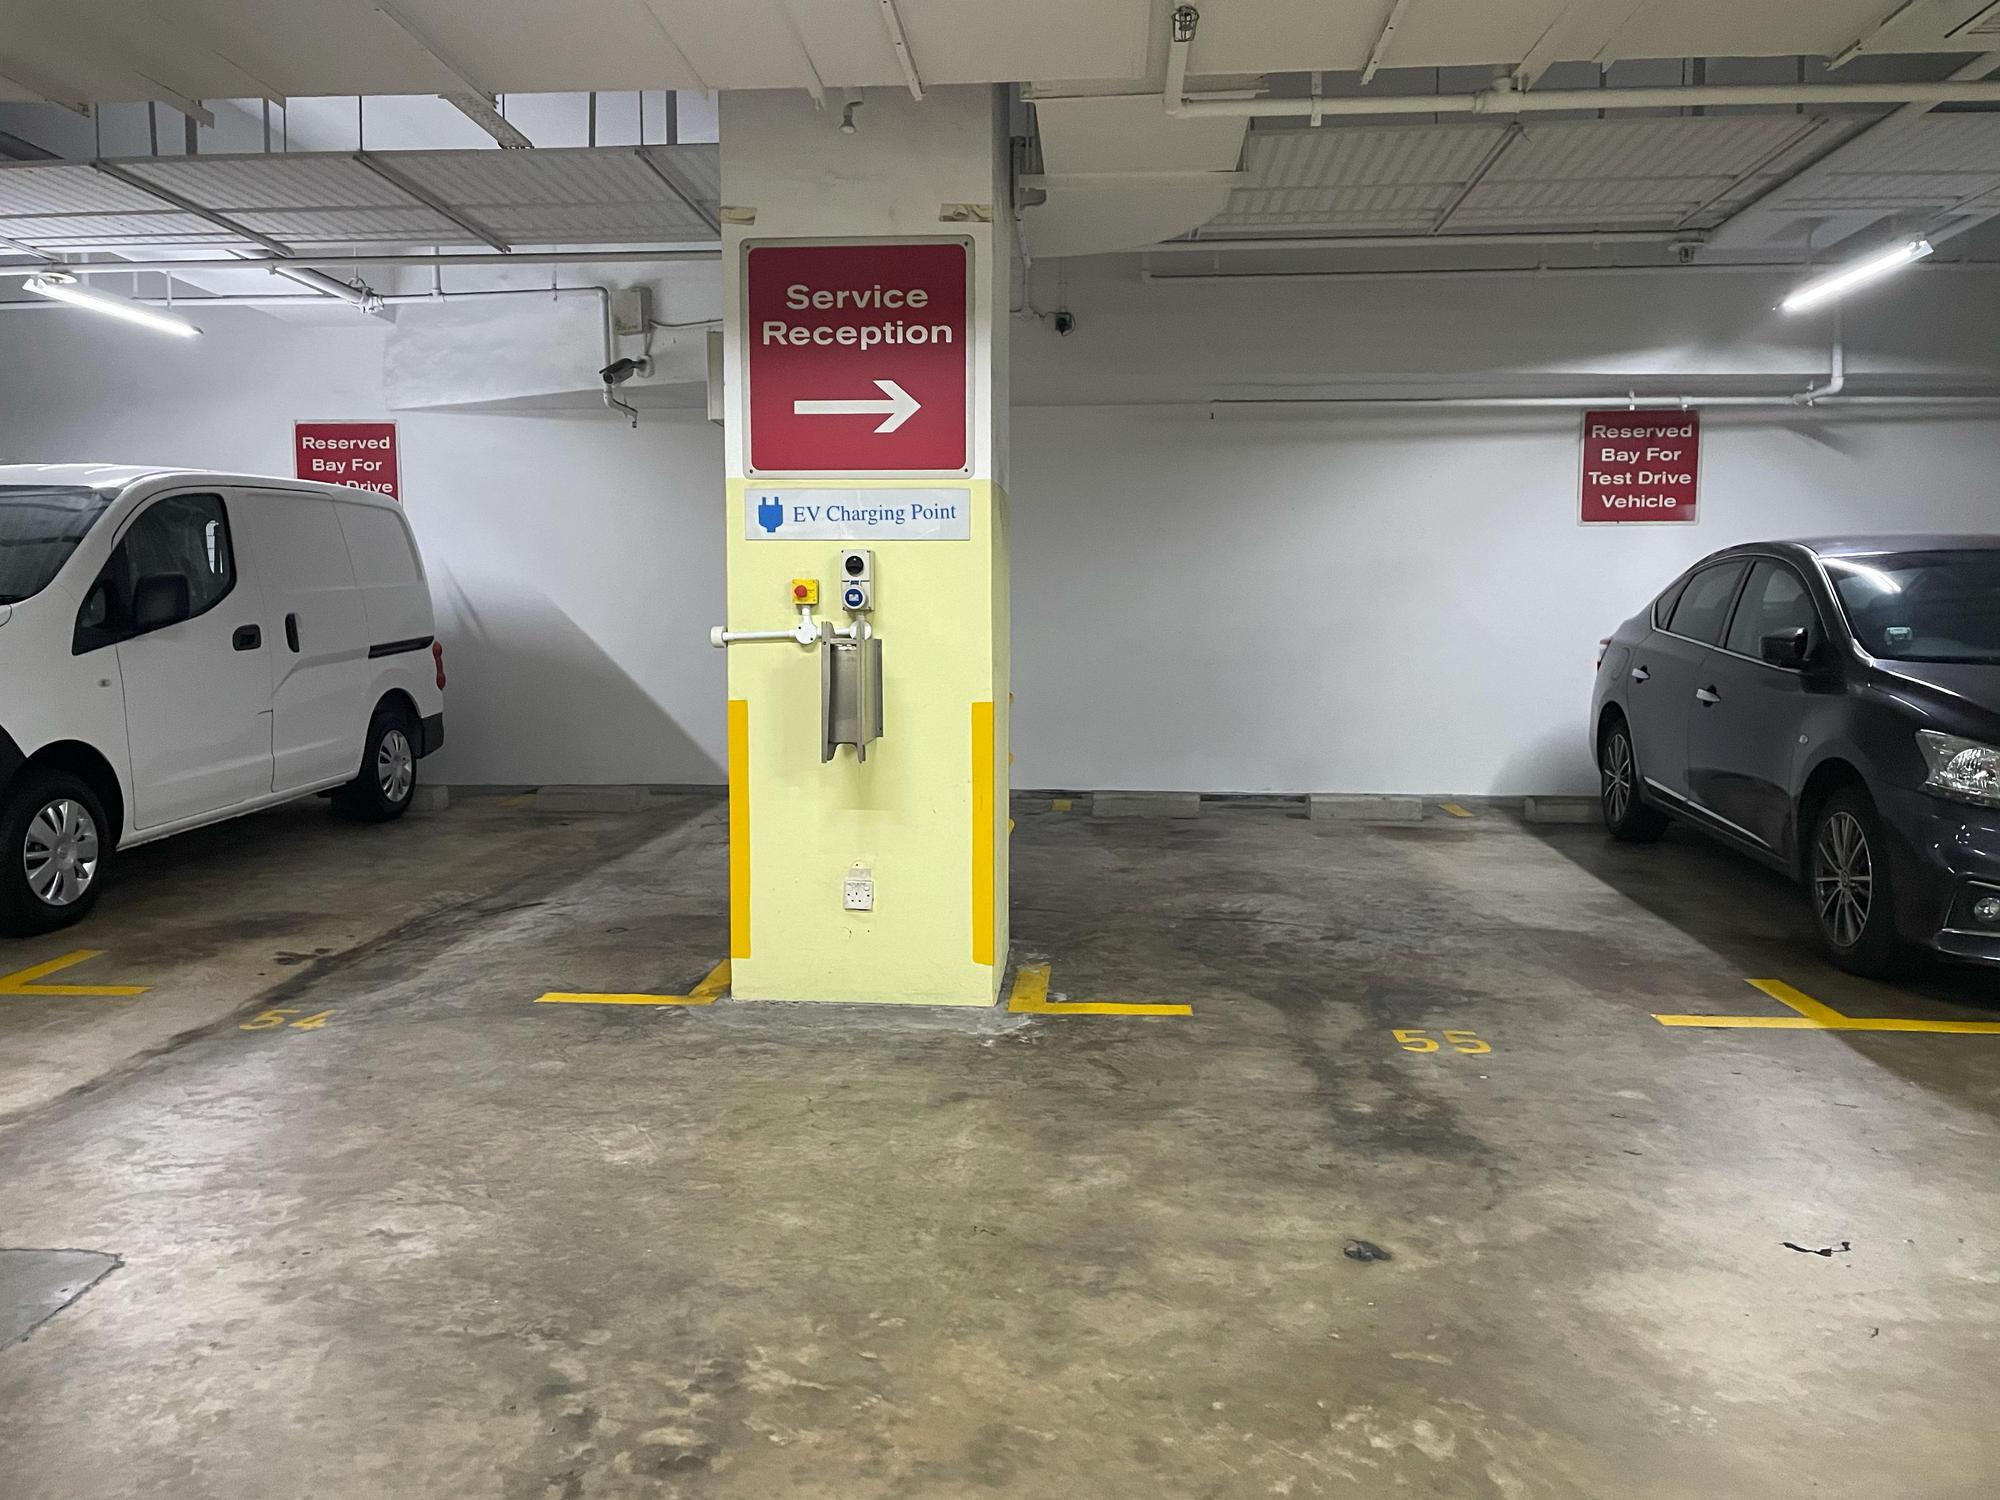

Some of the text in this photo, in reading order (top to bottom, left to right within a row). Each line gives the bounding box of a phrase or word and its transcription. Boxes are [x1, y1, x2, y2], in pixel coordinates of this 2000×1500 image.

[785, 284, 928, 310] Service
[762, 320, 953, 350] Reception
[1591, 424, 1692, 438] Reserved
[302, 436, 390, 449] Reserved
[1601, 447, 1682, 464] Bay For
[312, 458, 382, 474] Bay For
[1588, 471, 1691, 485] Test Drive
[1601, 494, 1677, 508] Vehicle
[793, 503, 957, 526] EV Charging Point
[239, 1009, 337, 1030] 54
[1391, 1029, 1492, 1054] 55
